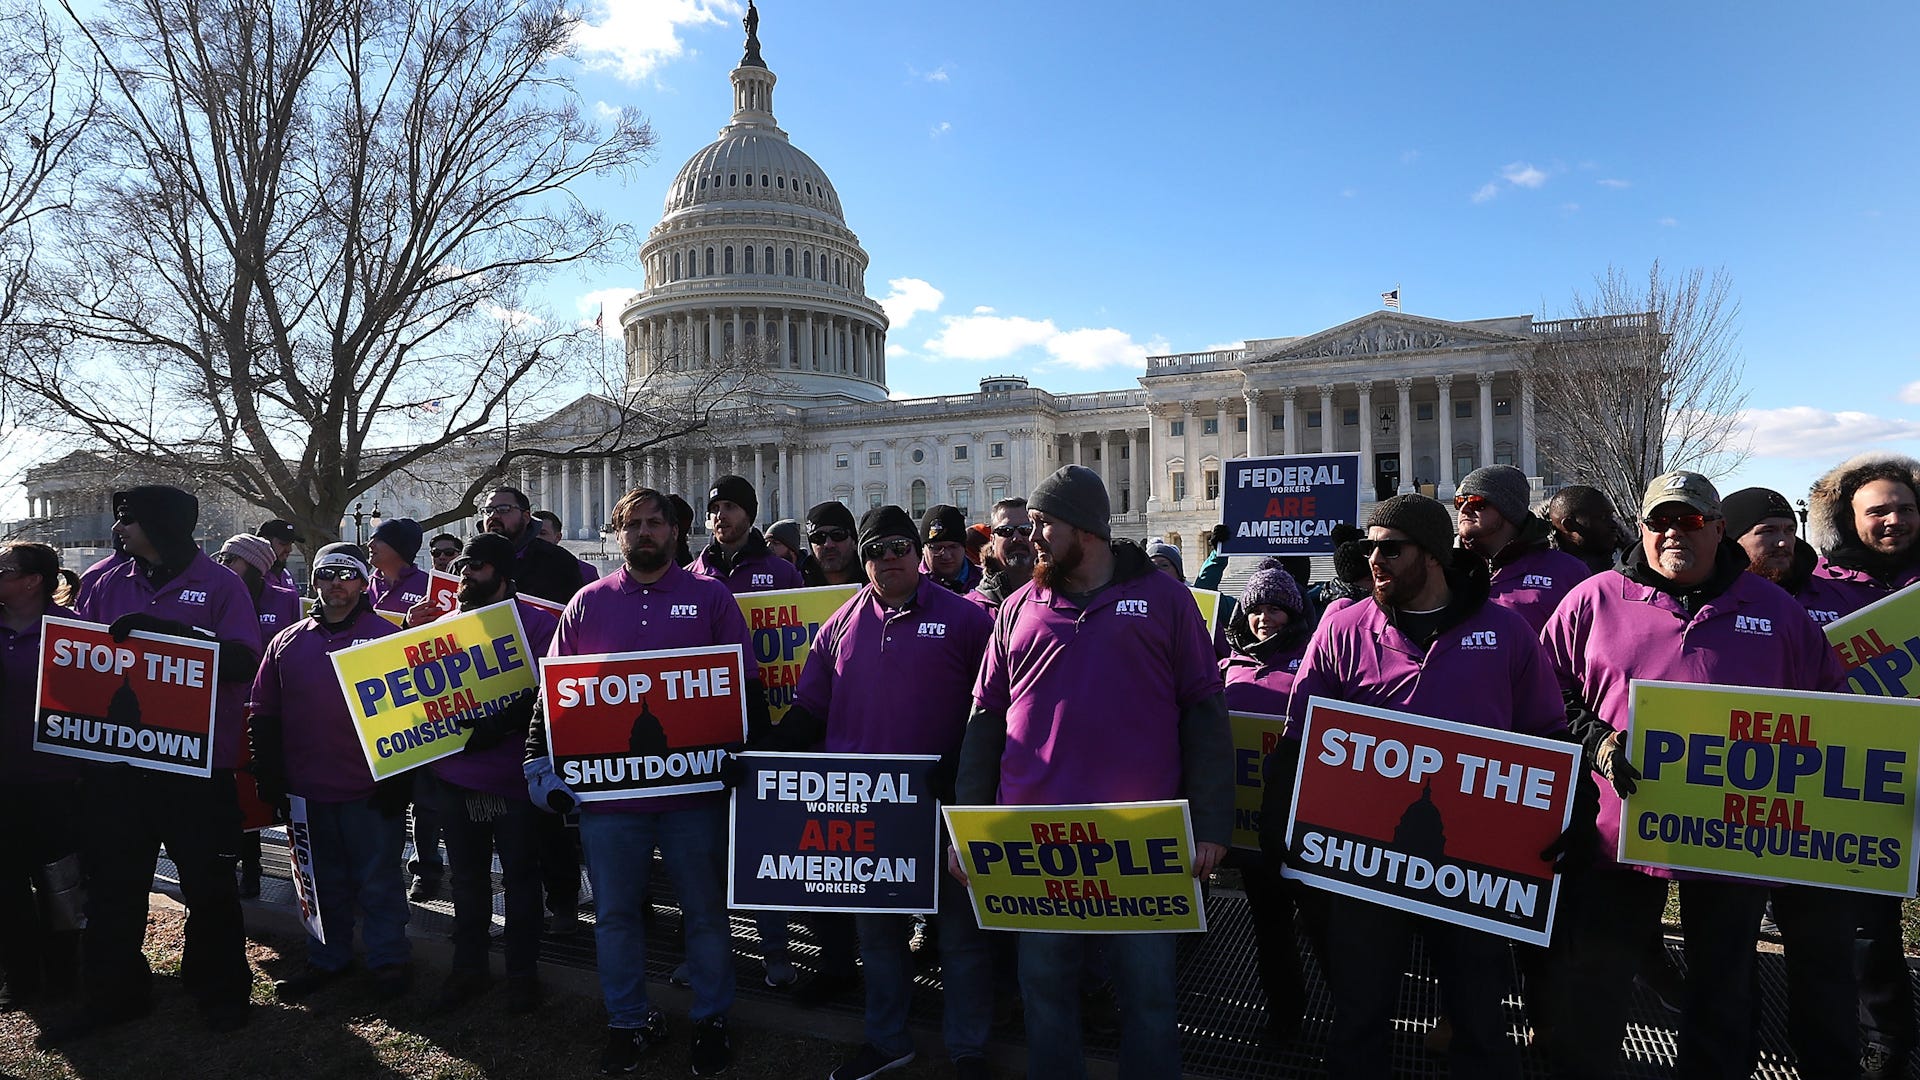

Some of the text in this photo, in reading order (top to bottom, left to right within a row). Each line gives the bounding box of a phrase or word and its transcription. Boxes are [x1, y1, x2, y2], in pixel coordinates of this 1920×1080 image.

[1238, 465, 1345, 488] FEDERAL
[1270, 486, 1311, 494] WORKERS
[1264, 496, 1317, 518] ARE
[1268, 537, 1309, 545] WORKERS
[751, 574, 773, 585] ATC
[1522, 574, 1552, 587] ATC
[180, 590, 207, 603] ATC
[402, 592, 422, 602] ATC
[1115, 600, 1148, 613] ATC
[670, 604, 697, 616] ATC
[751, 605, 803, 630] REAL
[1735, 614, 1772, 632] ATC
[917, 622, 946, 635] ATC
[1461, 630, 1497, 646] ATC
[53, 638, 205, 688] STOP THE
[404, 633, 465, 668] REAL
[1832, 628, 1897, 672] EAL
[355, 634, 524, 718] PEOPLE
[557, 673, 652, 708] STOP
[660, 666, 731, 701] THE
[423, 688, 483, 723] REAL
[46, 714, 200, 760] SHUTDOWN
[1729, 709, 1817, 748] REAL
[1318, 728, 1444, 784] STOP
[1456, 752, 1556, 811] THE
[1642, 729, 1907, 805] PEOPLE
[757, 770, 918, 803] FEDERAL
[806, 802, 868, 813] WORKERS
[1723, 792, 1811, 833] REAL
[293, 822, 311, 866] We
[798, 819, 876, 852] ARE
[1030, 822, 1106, 845] REAL
[1638, 811, 1901, 869] CONSEQUENCES
[756, 854, 916, 883] AMERICAN
[967, 838, 1184, 877] PEOPLE
[1300, 831, 1538, 917] SHUTDOWN
[804, 882, 866, 894] WORKERS
[1044, 879, 1118, 901] REAL
[984, 894, 1190, 920] CONSEQUENCES
